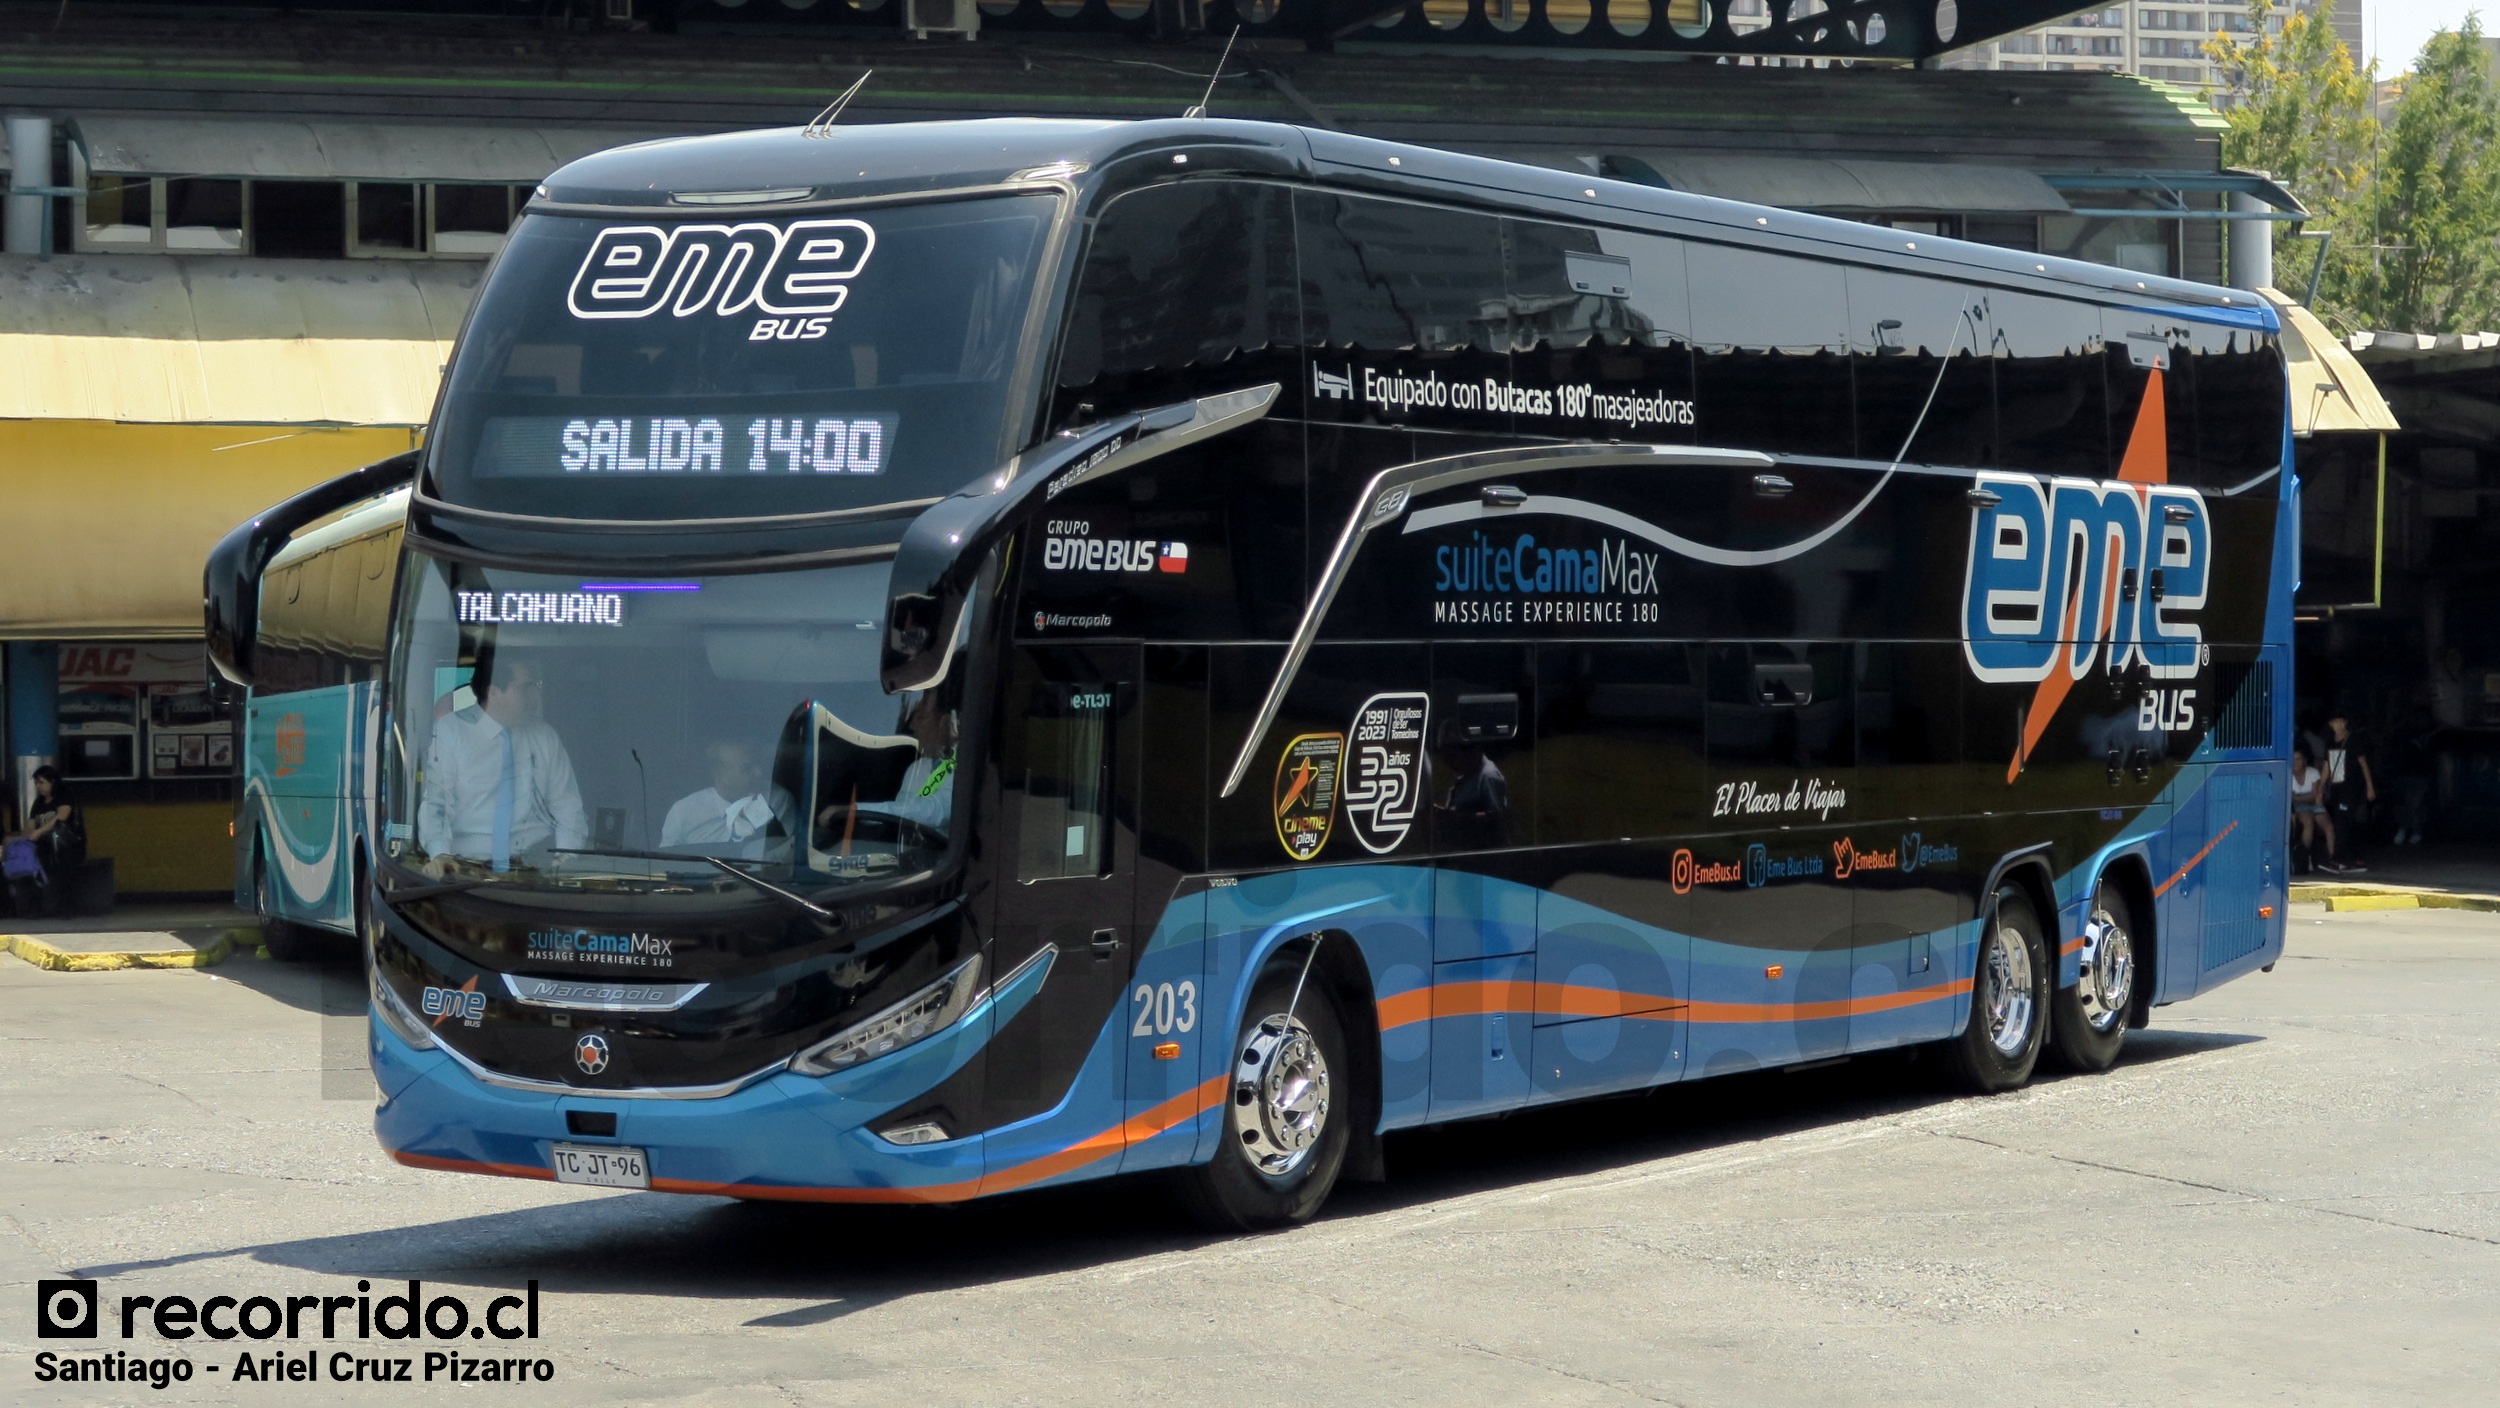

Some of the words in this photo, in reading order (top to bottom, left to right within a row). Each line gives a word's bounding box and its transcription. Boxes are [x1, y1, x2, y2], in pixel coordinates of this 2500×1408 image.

[568, 219, 876, 319] eme
[748, 317, 832, 341] BUS
[1365, 368, 1447, 412] Equipado
[1451, 386, 1481, 410] con
[1485, 379, 1552, 416] Butacas
[1594, 390, 1694, 428] masajeadoras
[561, 418, 724, 473] SALIDA
[748, 418, 883, 473] 14:00
[1047, 520, 1089, 535] GRUPO
[1962, 470, 2212, 683] eme
[458, 592, 623, 624] TALCAHUANO
[1435, 602, 1512, 623] MASSAGE
[1524, 603, 1622, 622] EXPERIENCE
[1632, 604, 1658, 623] 180
[1046, 614, 1112, 628] Marcopolo
[1365, 710, 1389, 725] 1991
[2138, 689, 2196, 731] BUS
[1358, 726, 1387, 741] 2023
[1388, 751, 1411, 766] años
[1713, 783, 1734, 817] El
[1735, 781, 1780, 814] Placer
[1784, 779, 1800, 811] de
[1804, 778, 1846, 822] Viajar
[1295, 831, 1318, 847] play
[1855, 849, 1896, 870] EmeBus.cl
[1920, 845, 1957, 865] @EmeBus
[1694, 861, 1740, 884] EmeBus.cl
[1767, 860, 1784, 877] Eme
[1787, 858, 1802, 876] Bus
[1804, 856, 1823, 875] Ltda
[527, 950, 574, 961] MASSAGE
[579, 953, 646, 966] EXPERIENCE
[652, 958, 672, 967] 180
[534, 983, 664, 1001] Marcopolo
[422, 987, 485, 1020] eme
[1132, 980, 1196, 1037] 203
[464, 1019, 481, 1028] BUS
